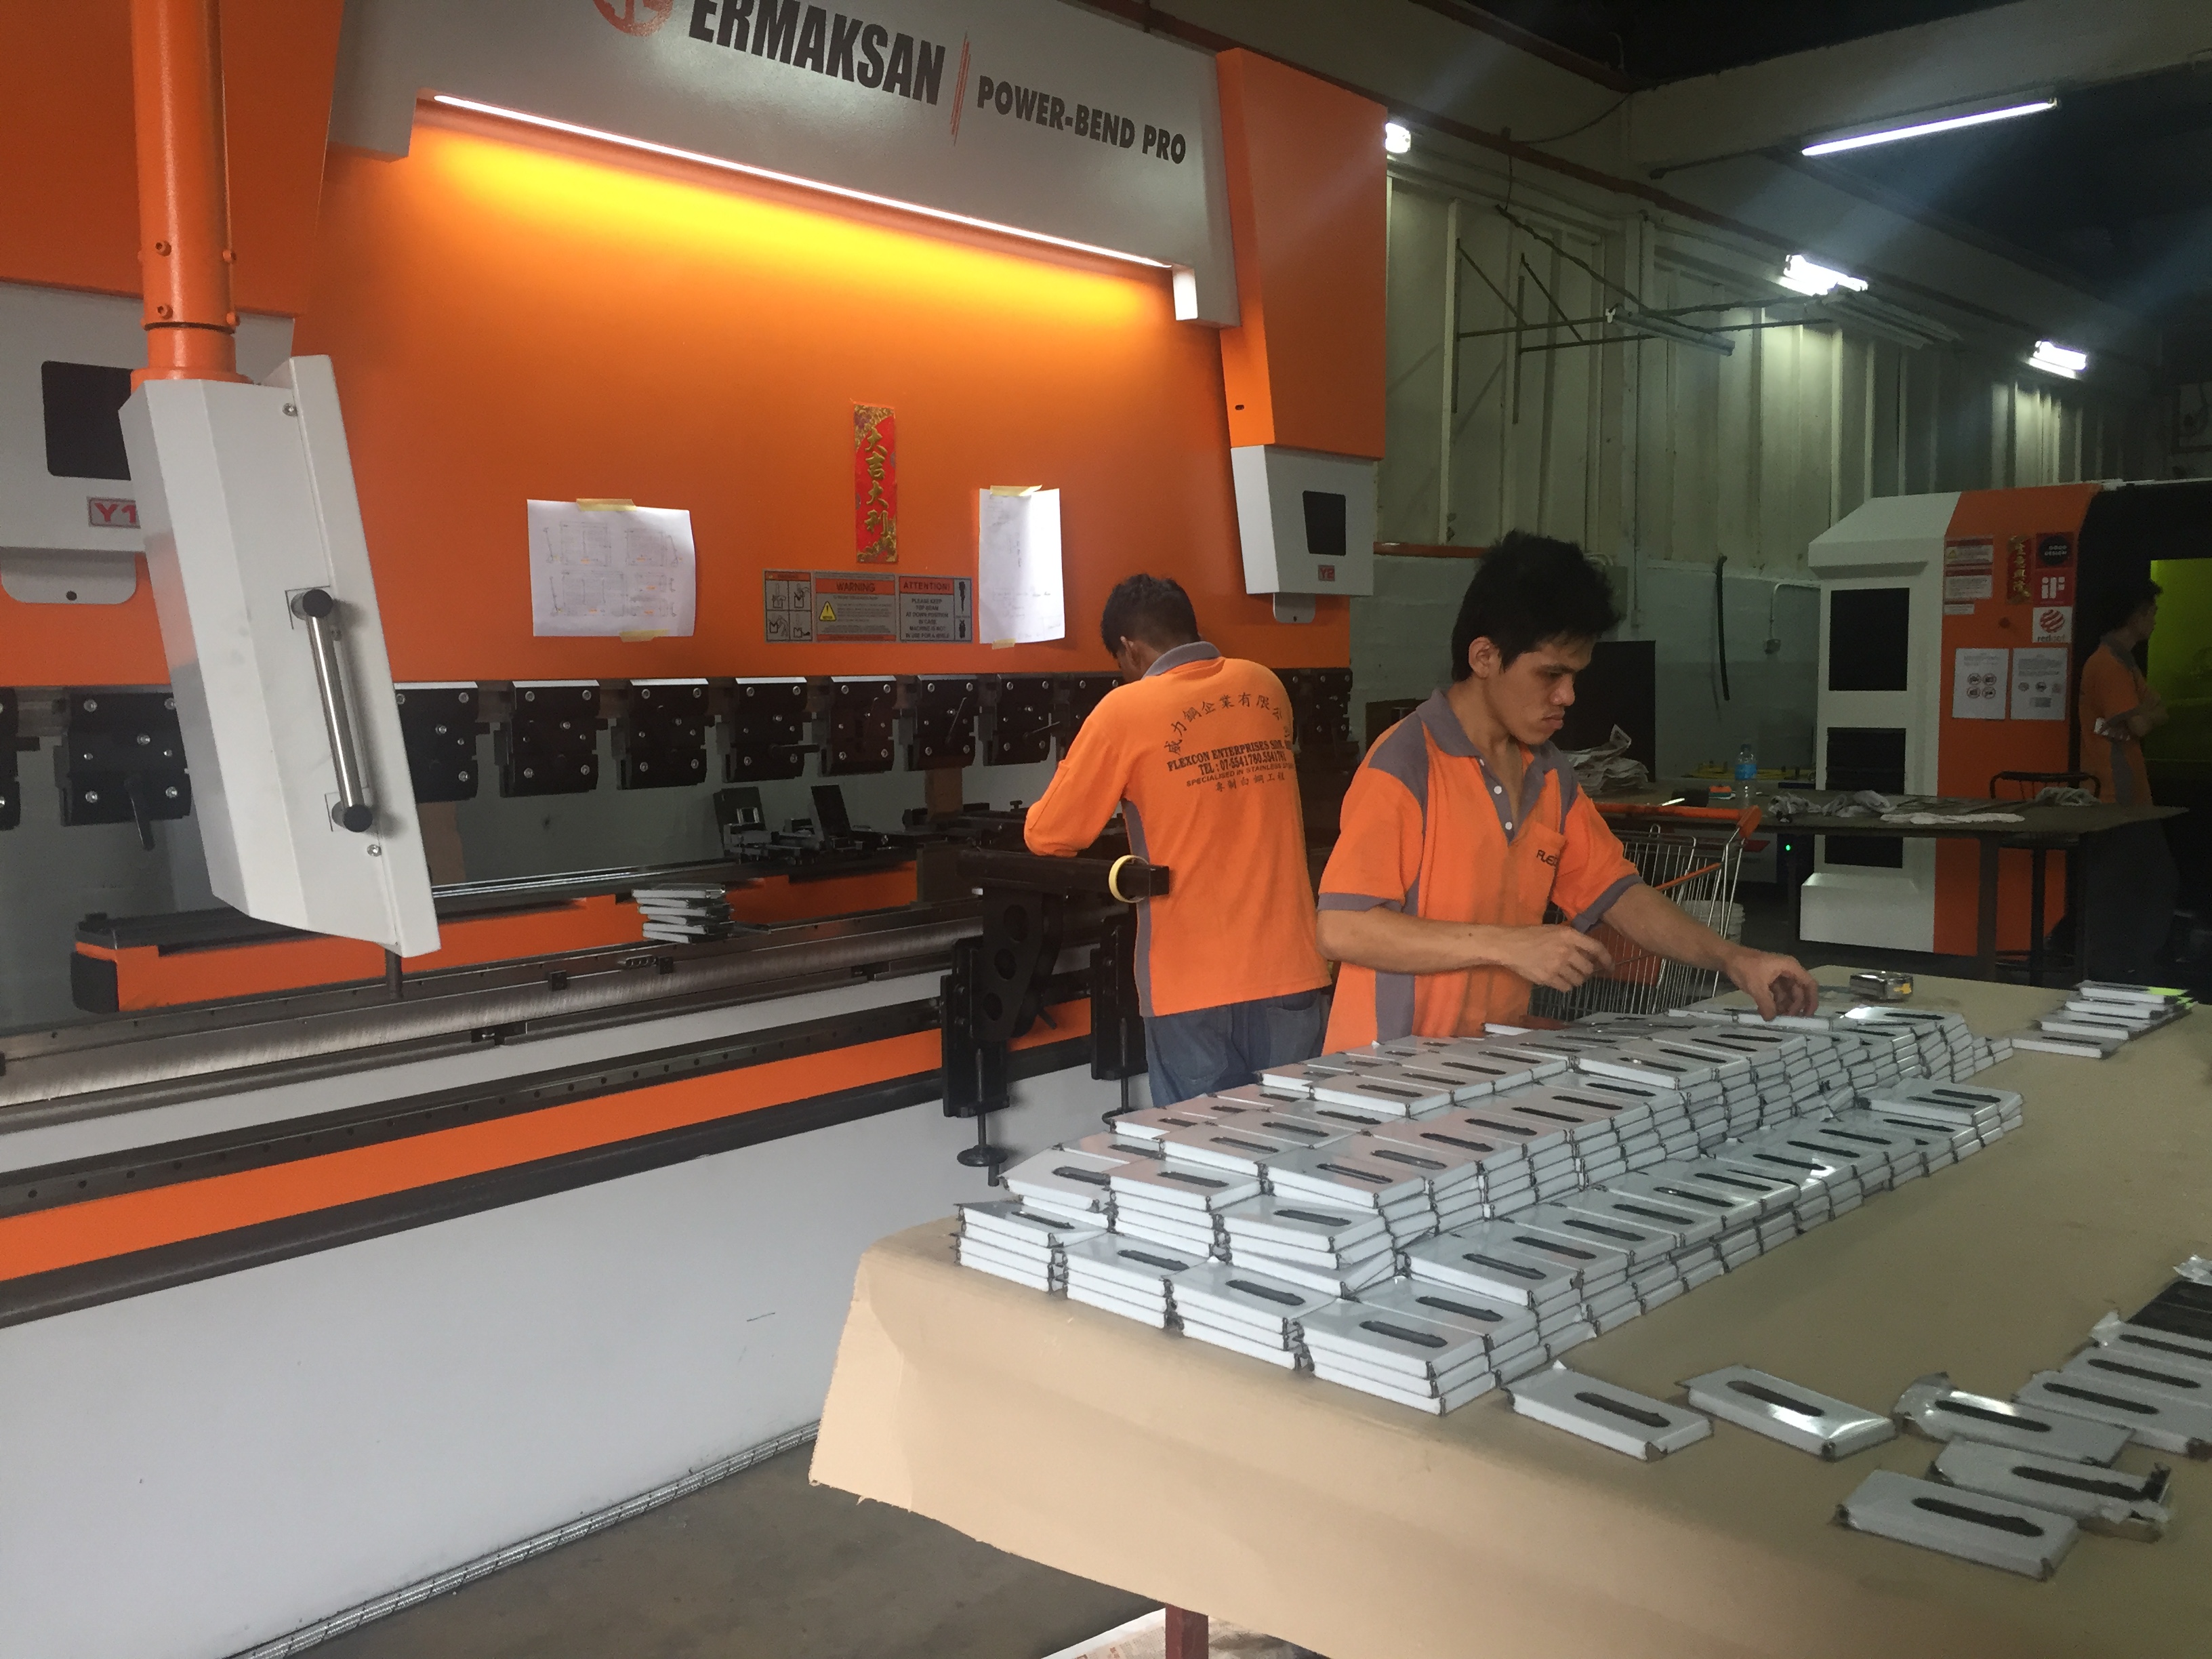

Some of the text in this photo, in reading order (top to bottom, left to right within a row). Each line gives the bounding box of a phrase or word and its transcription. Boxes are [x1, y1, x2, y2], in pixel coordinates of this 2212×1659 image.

[689, 0, 945, 106] ERMAKSAN
[977, 75, 1186, 164] POWER-BEND PRO
[864, 426, 889, 537] 大吉大利
[95, 502, 136, 523] Y1
[836, 581, 876, 592] WARNING
[1167, 751, 1210, 772] FLEXCON
[1211, 740, 1270, 760] ENTERPRISES
[1197, 762, 1214, 775] TEL
[1187, 771, 1235, 787] SPECIALISED
